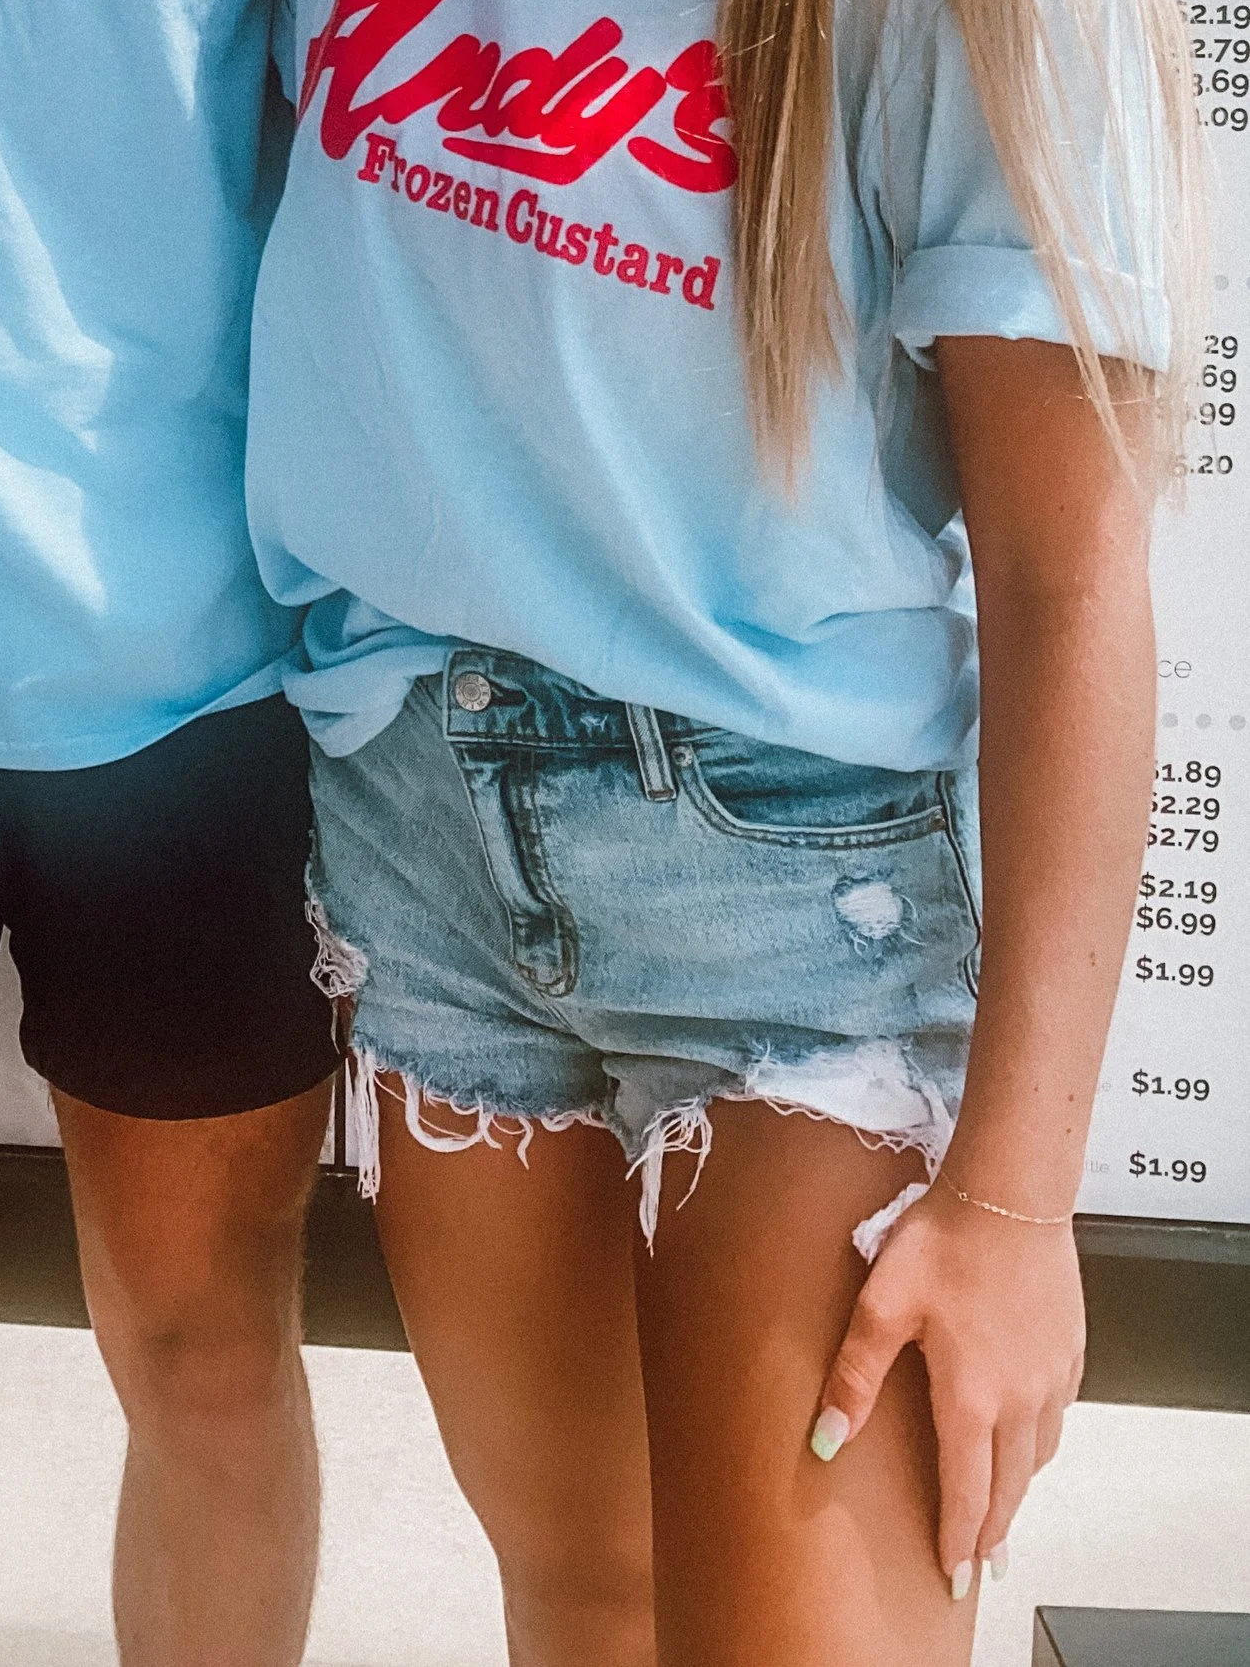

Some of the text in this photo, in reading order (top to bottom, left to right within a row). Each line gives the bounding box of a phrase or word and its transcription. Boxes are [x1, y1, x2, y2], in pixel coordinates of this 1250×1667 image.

[357, 132, 720, 310] Frozen Custard
[1138, 873, 1217, 904] $2.19
[1137, 904, 1216, 936] $6.99
[1136, 955, 1214, 987] $1.99
[1132, 1069, 1210, 1101] $1.99
[1129, 1151, 1206, 1183] $1.99
